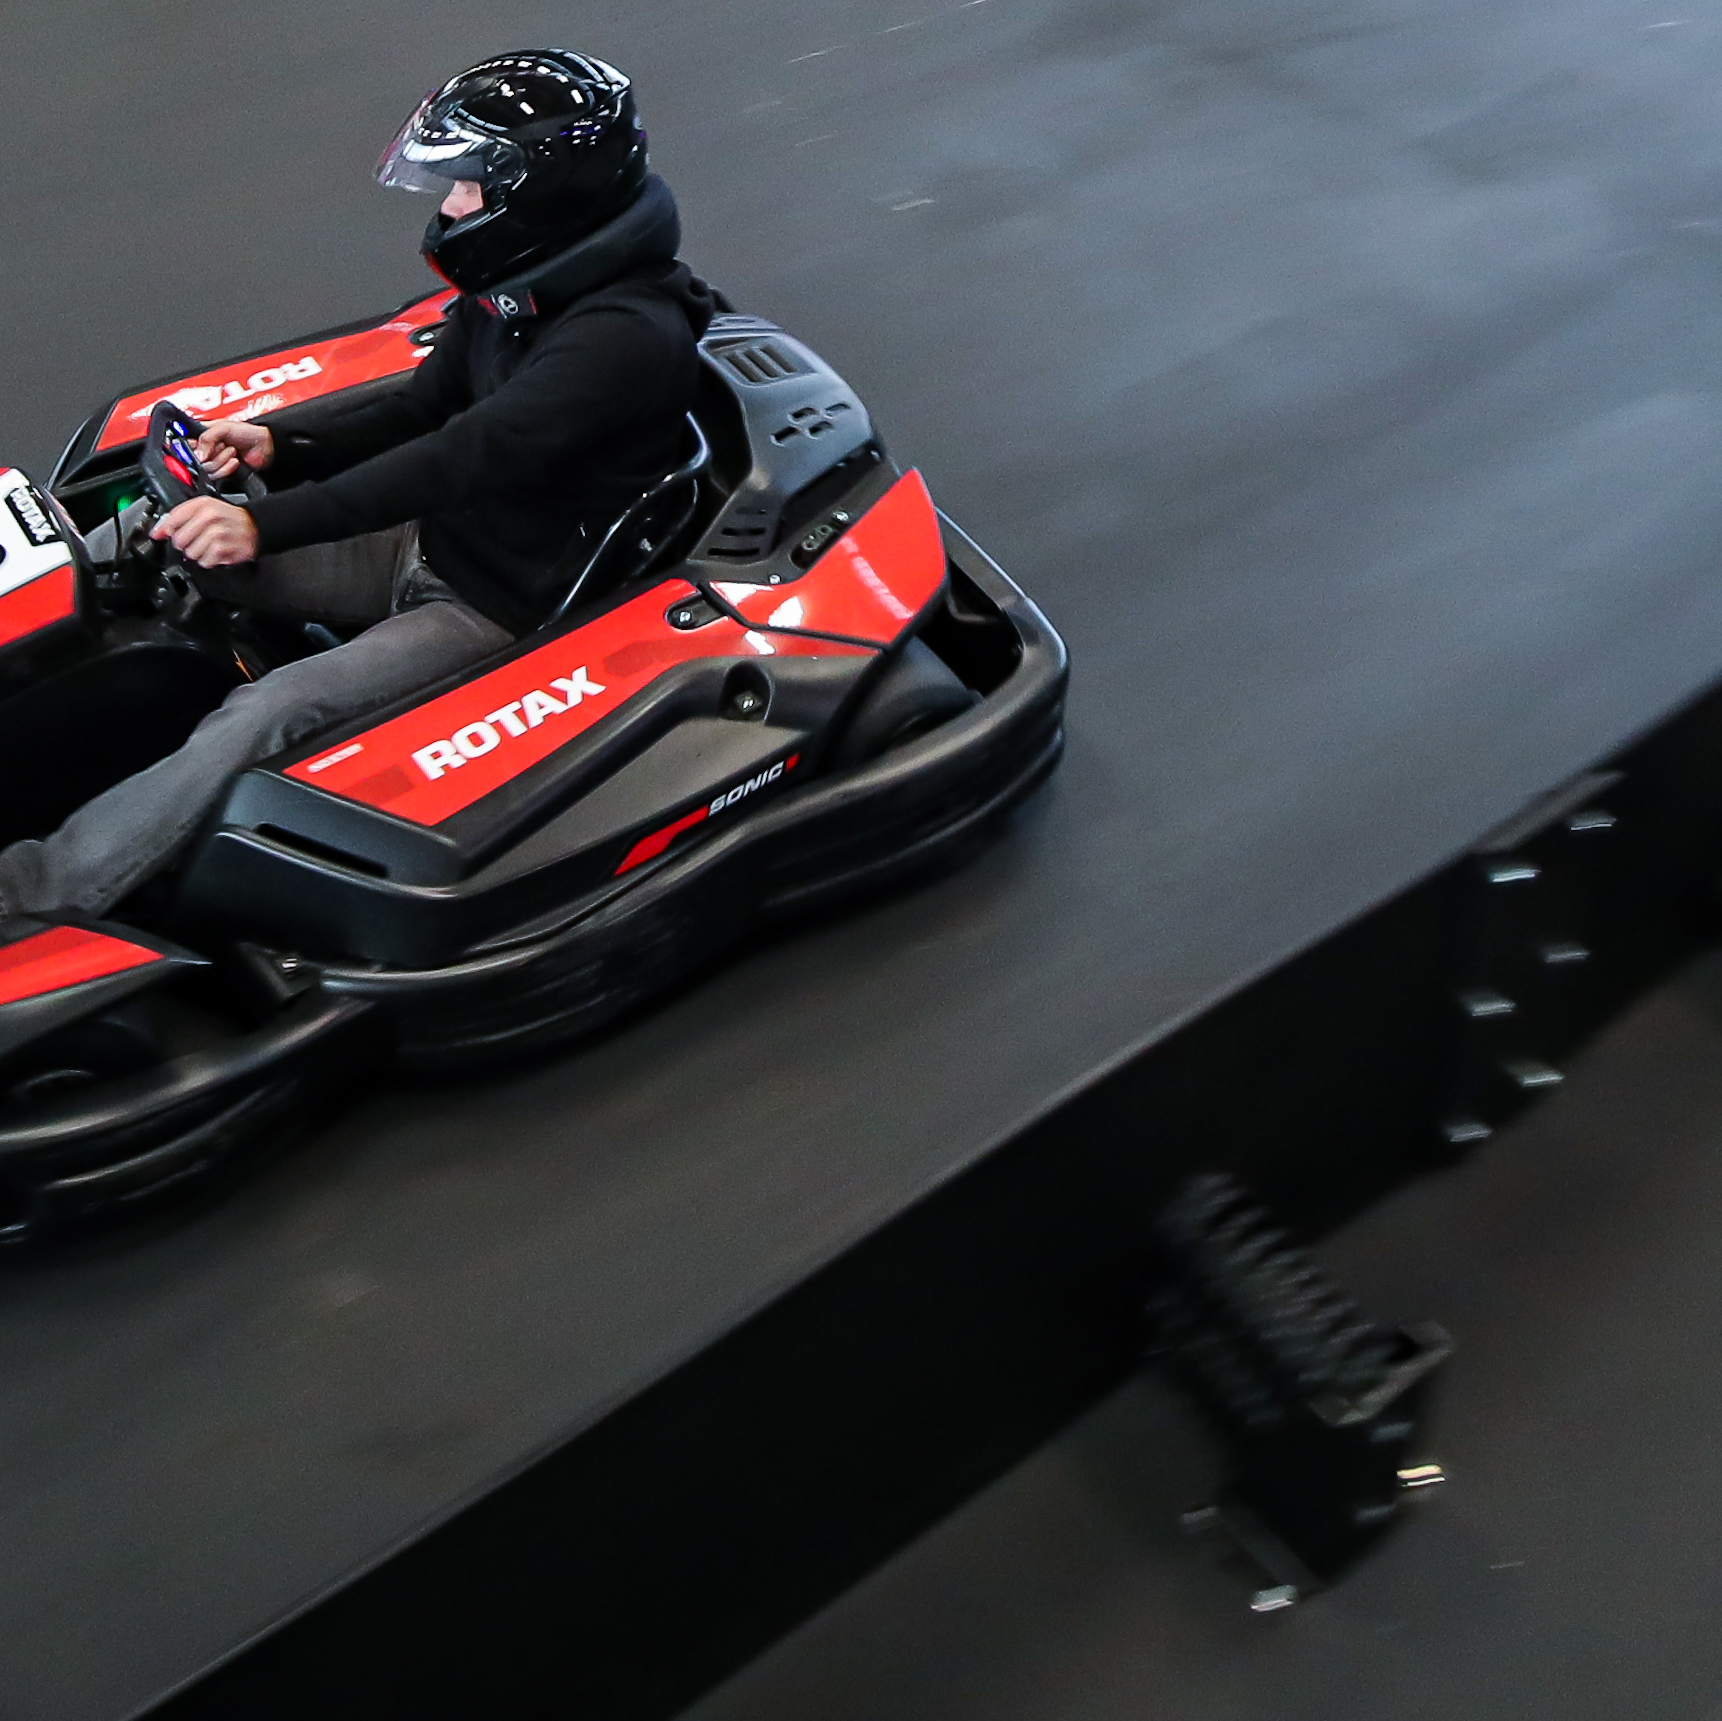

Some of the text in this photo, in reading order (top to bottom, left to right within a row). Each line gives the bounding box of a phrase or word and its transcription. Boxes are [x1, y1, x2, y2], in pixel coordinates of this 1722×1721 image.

[10, 484, 56, 543] ROTAX
[411, 665, 607, 781] ROTAX
[708, 760, 785, 817] SONIC
